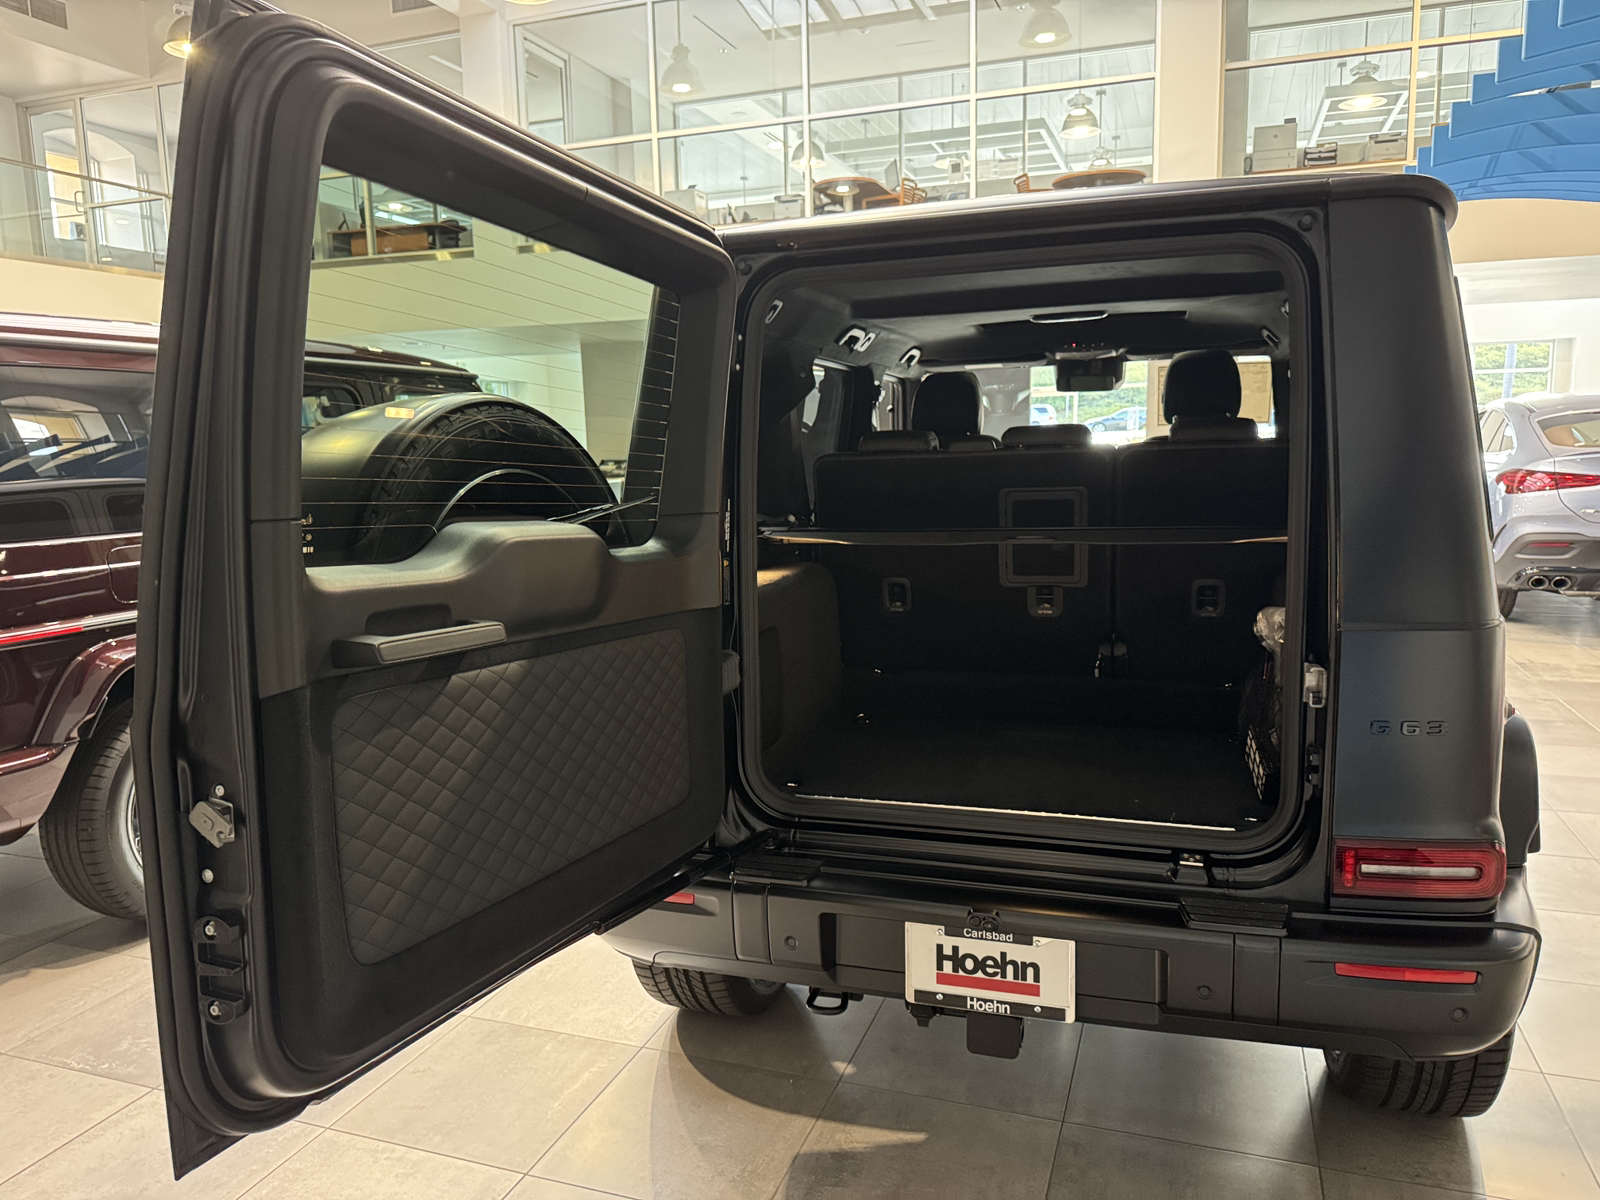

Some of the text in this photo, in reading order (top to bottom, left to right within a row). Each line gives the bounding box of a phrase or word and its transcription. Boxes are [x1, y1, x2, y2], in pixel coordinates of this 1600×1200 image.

[1370, 720, 1448, 736] G 63
[963, 928, 1014, 943] Carlsbad
[936, 943, 1041, 984] Hoehn
[966, 997, 1011, 1015] Hoehn
